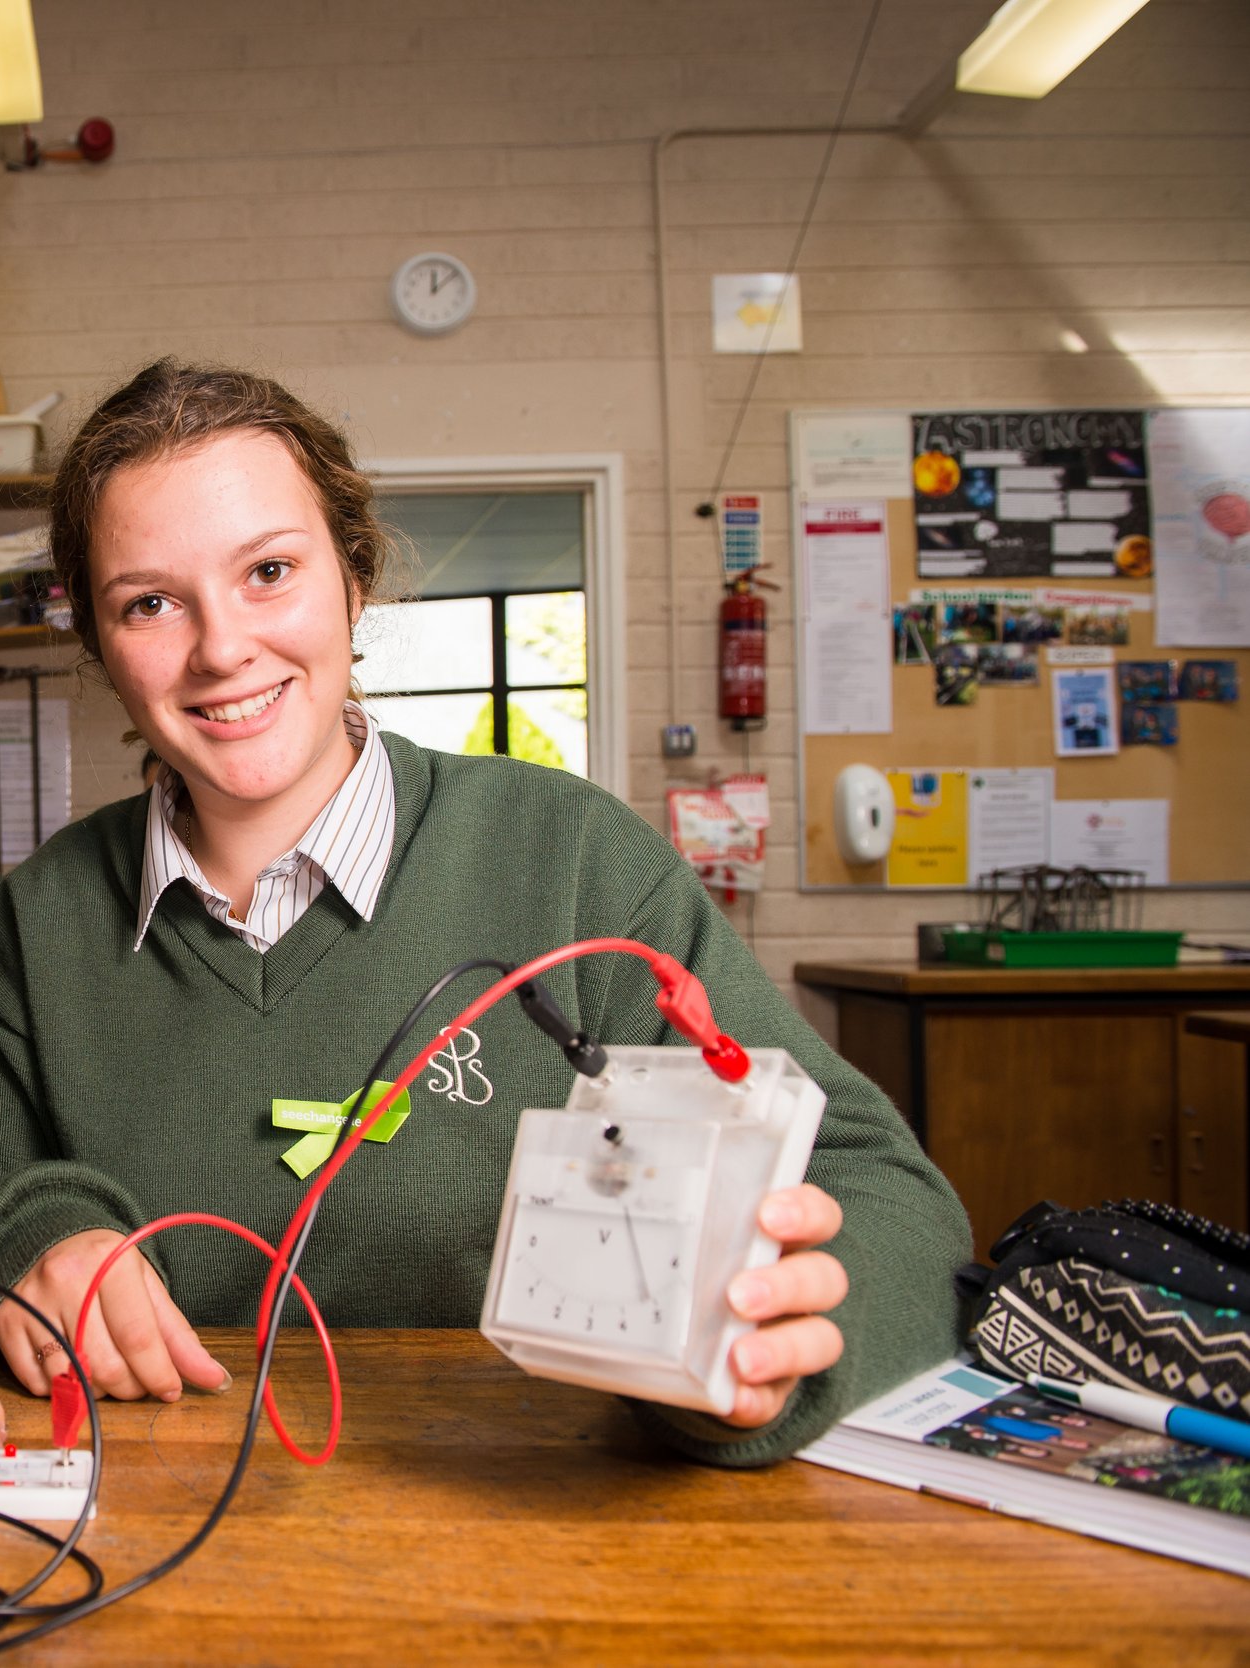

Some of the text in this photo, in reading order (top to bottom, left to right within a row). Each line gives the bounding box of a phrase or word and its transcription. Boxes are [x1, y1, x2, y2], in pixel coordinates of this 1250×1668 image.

[824, 508, 863, 521] FIRE
[281, 1109, 363, 1128] seechangee
[529, 1234, 538, 1248] 0
[599, 1229, 612, 1245] V
[553, 1304, 562, 1320] 2
[653, 1308, 662, 1325] 5
[585, 1316, 594, 1332] 3
